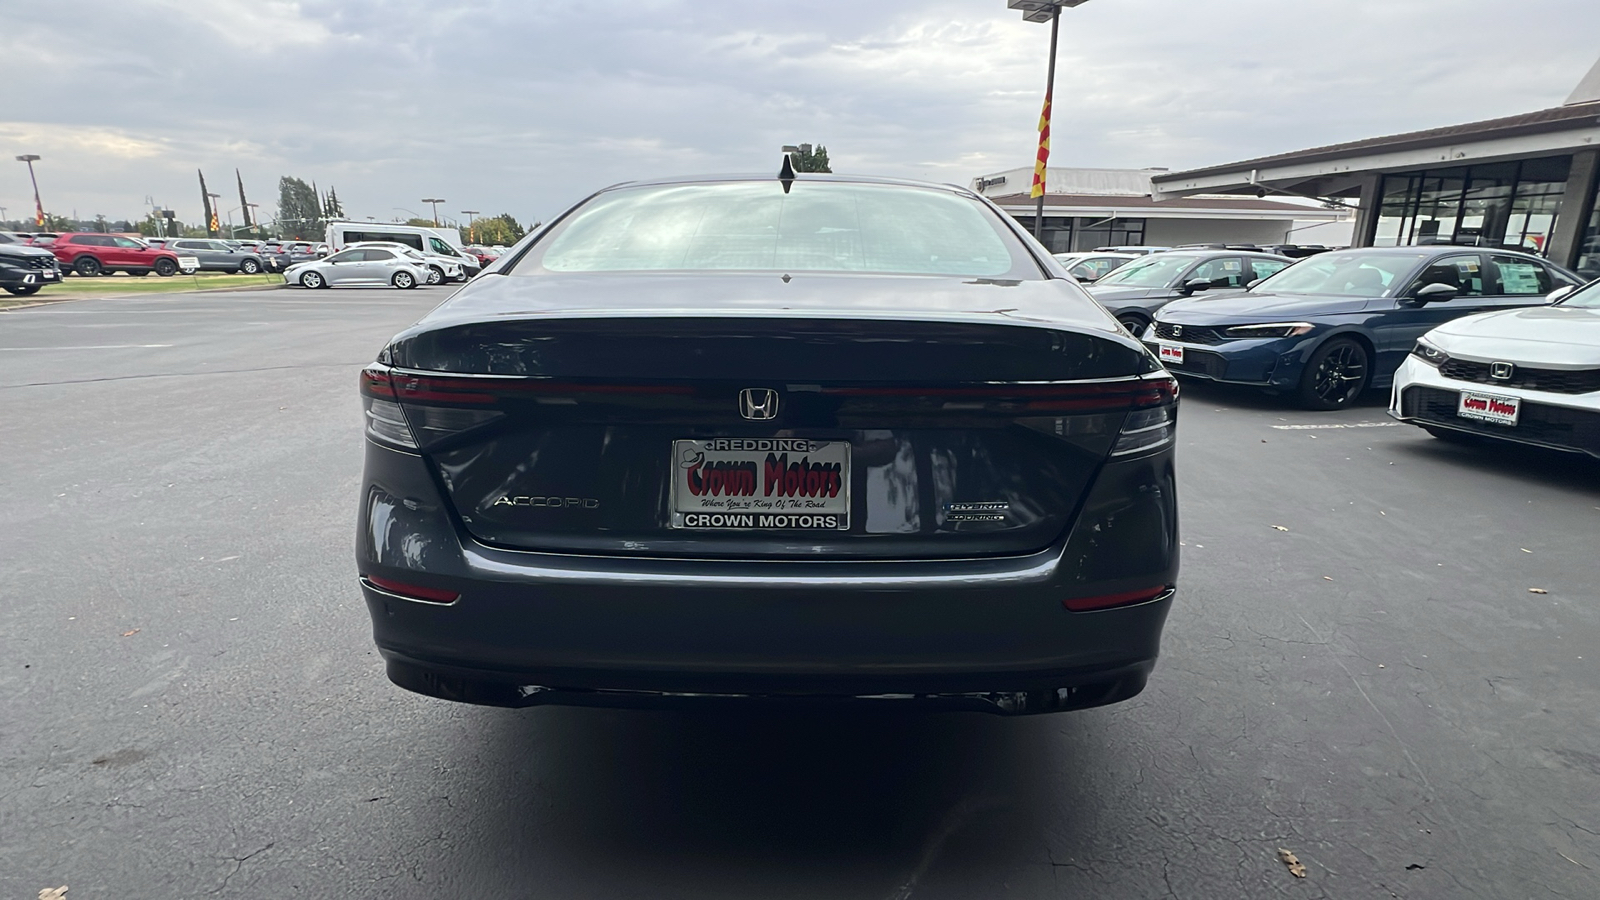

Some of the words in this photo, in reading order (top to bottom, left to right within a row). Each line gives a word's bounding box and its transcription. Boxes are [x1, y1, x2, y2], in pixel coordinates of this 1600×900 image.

[715, 440, 809, 451] REDDING
[687, 452, 757, 497] Crown
[764, 452, 841, 498] Motors
[493, 495, 600, 509] ACCORD
[701, 499, 725, 508] Where
[726, 499, 751, 511] You're
[754, 500, 773, 510] King
[775, 500, 787, 510] Of
[789, 500, 803, 509] The
[804, 500, 826, 509] Road
[685, 514, 754, 527] CROWN
[759, 515, 837, 529] MOTORS
